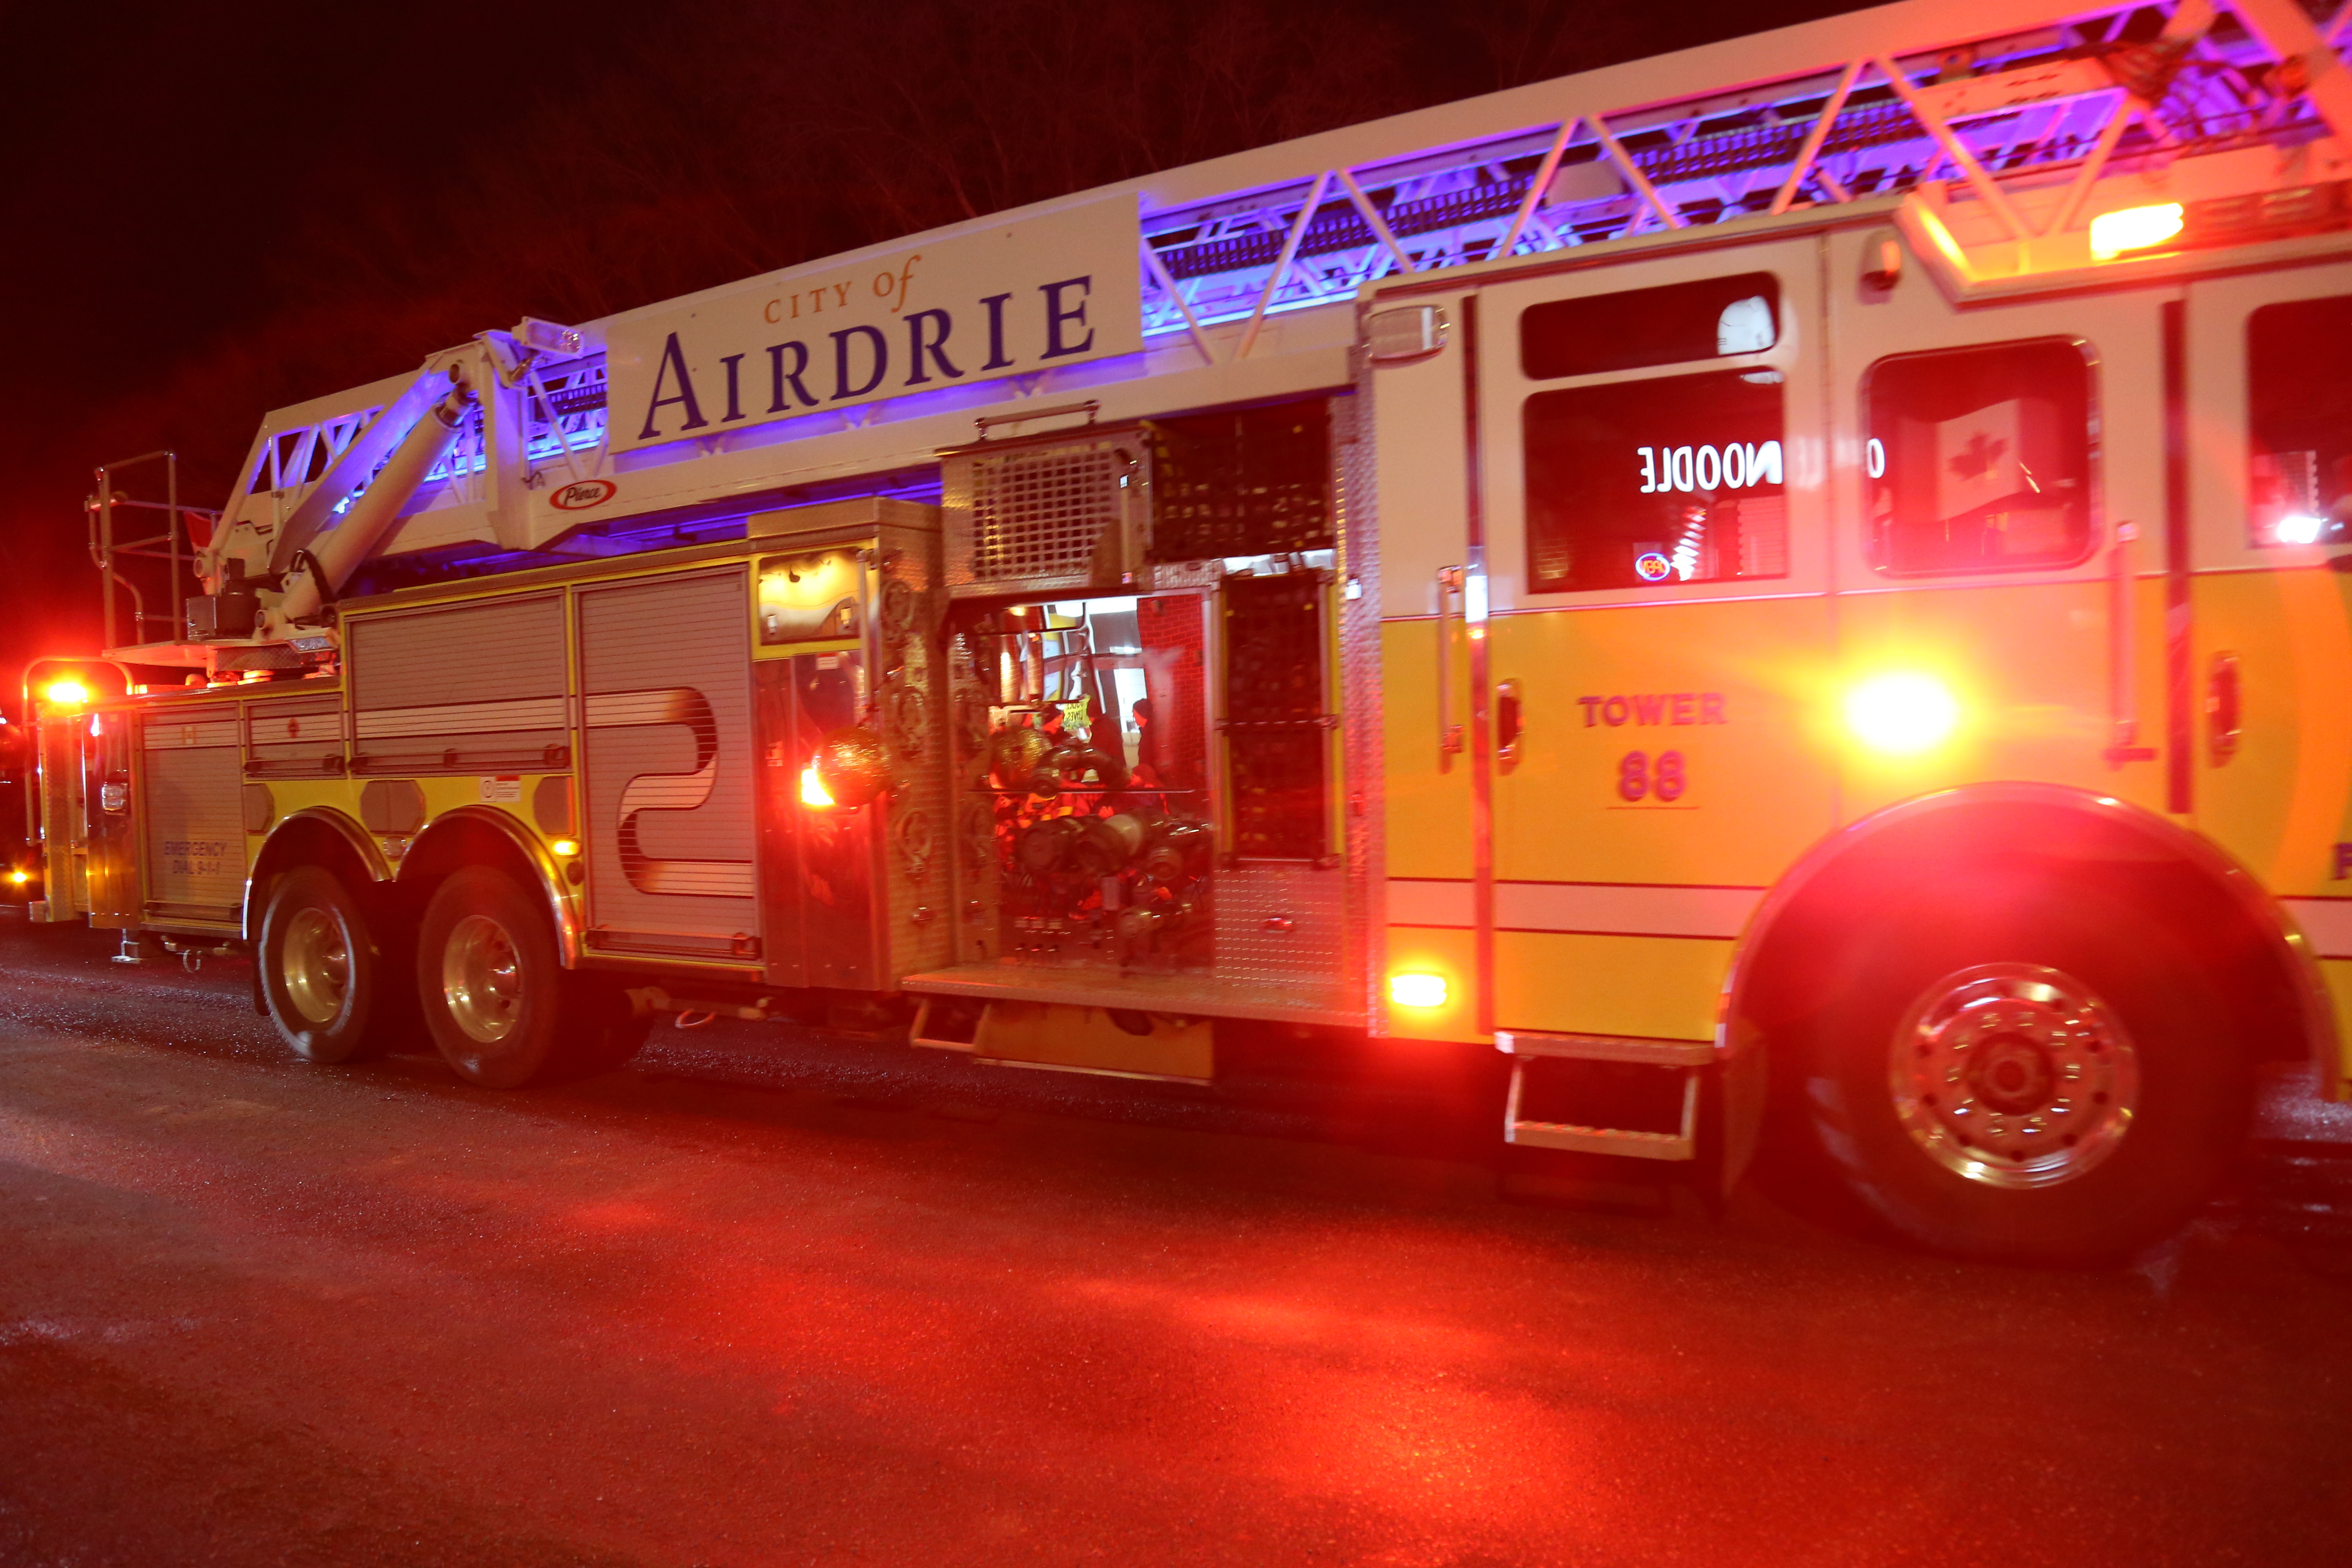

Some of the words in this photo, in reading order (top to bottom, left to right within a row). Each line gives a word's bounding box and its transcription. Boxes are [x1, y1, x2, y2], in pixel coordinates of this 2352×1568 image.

[765, 281, 852, 324] CITY
[873, 255, 921, 313] of
[638, 275, 1096, 440] AIRDRIE
[1578, 692, 1728, 728] TOWER
[1617, 750, 1687, 803] 88
[165, 841, 226, 857] EMERGENCY
[173, 860, 194, 874] DIAL
